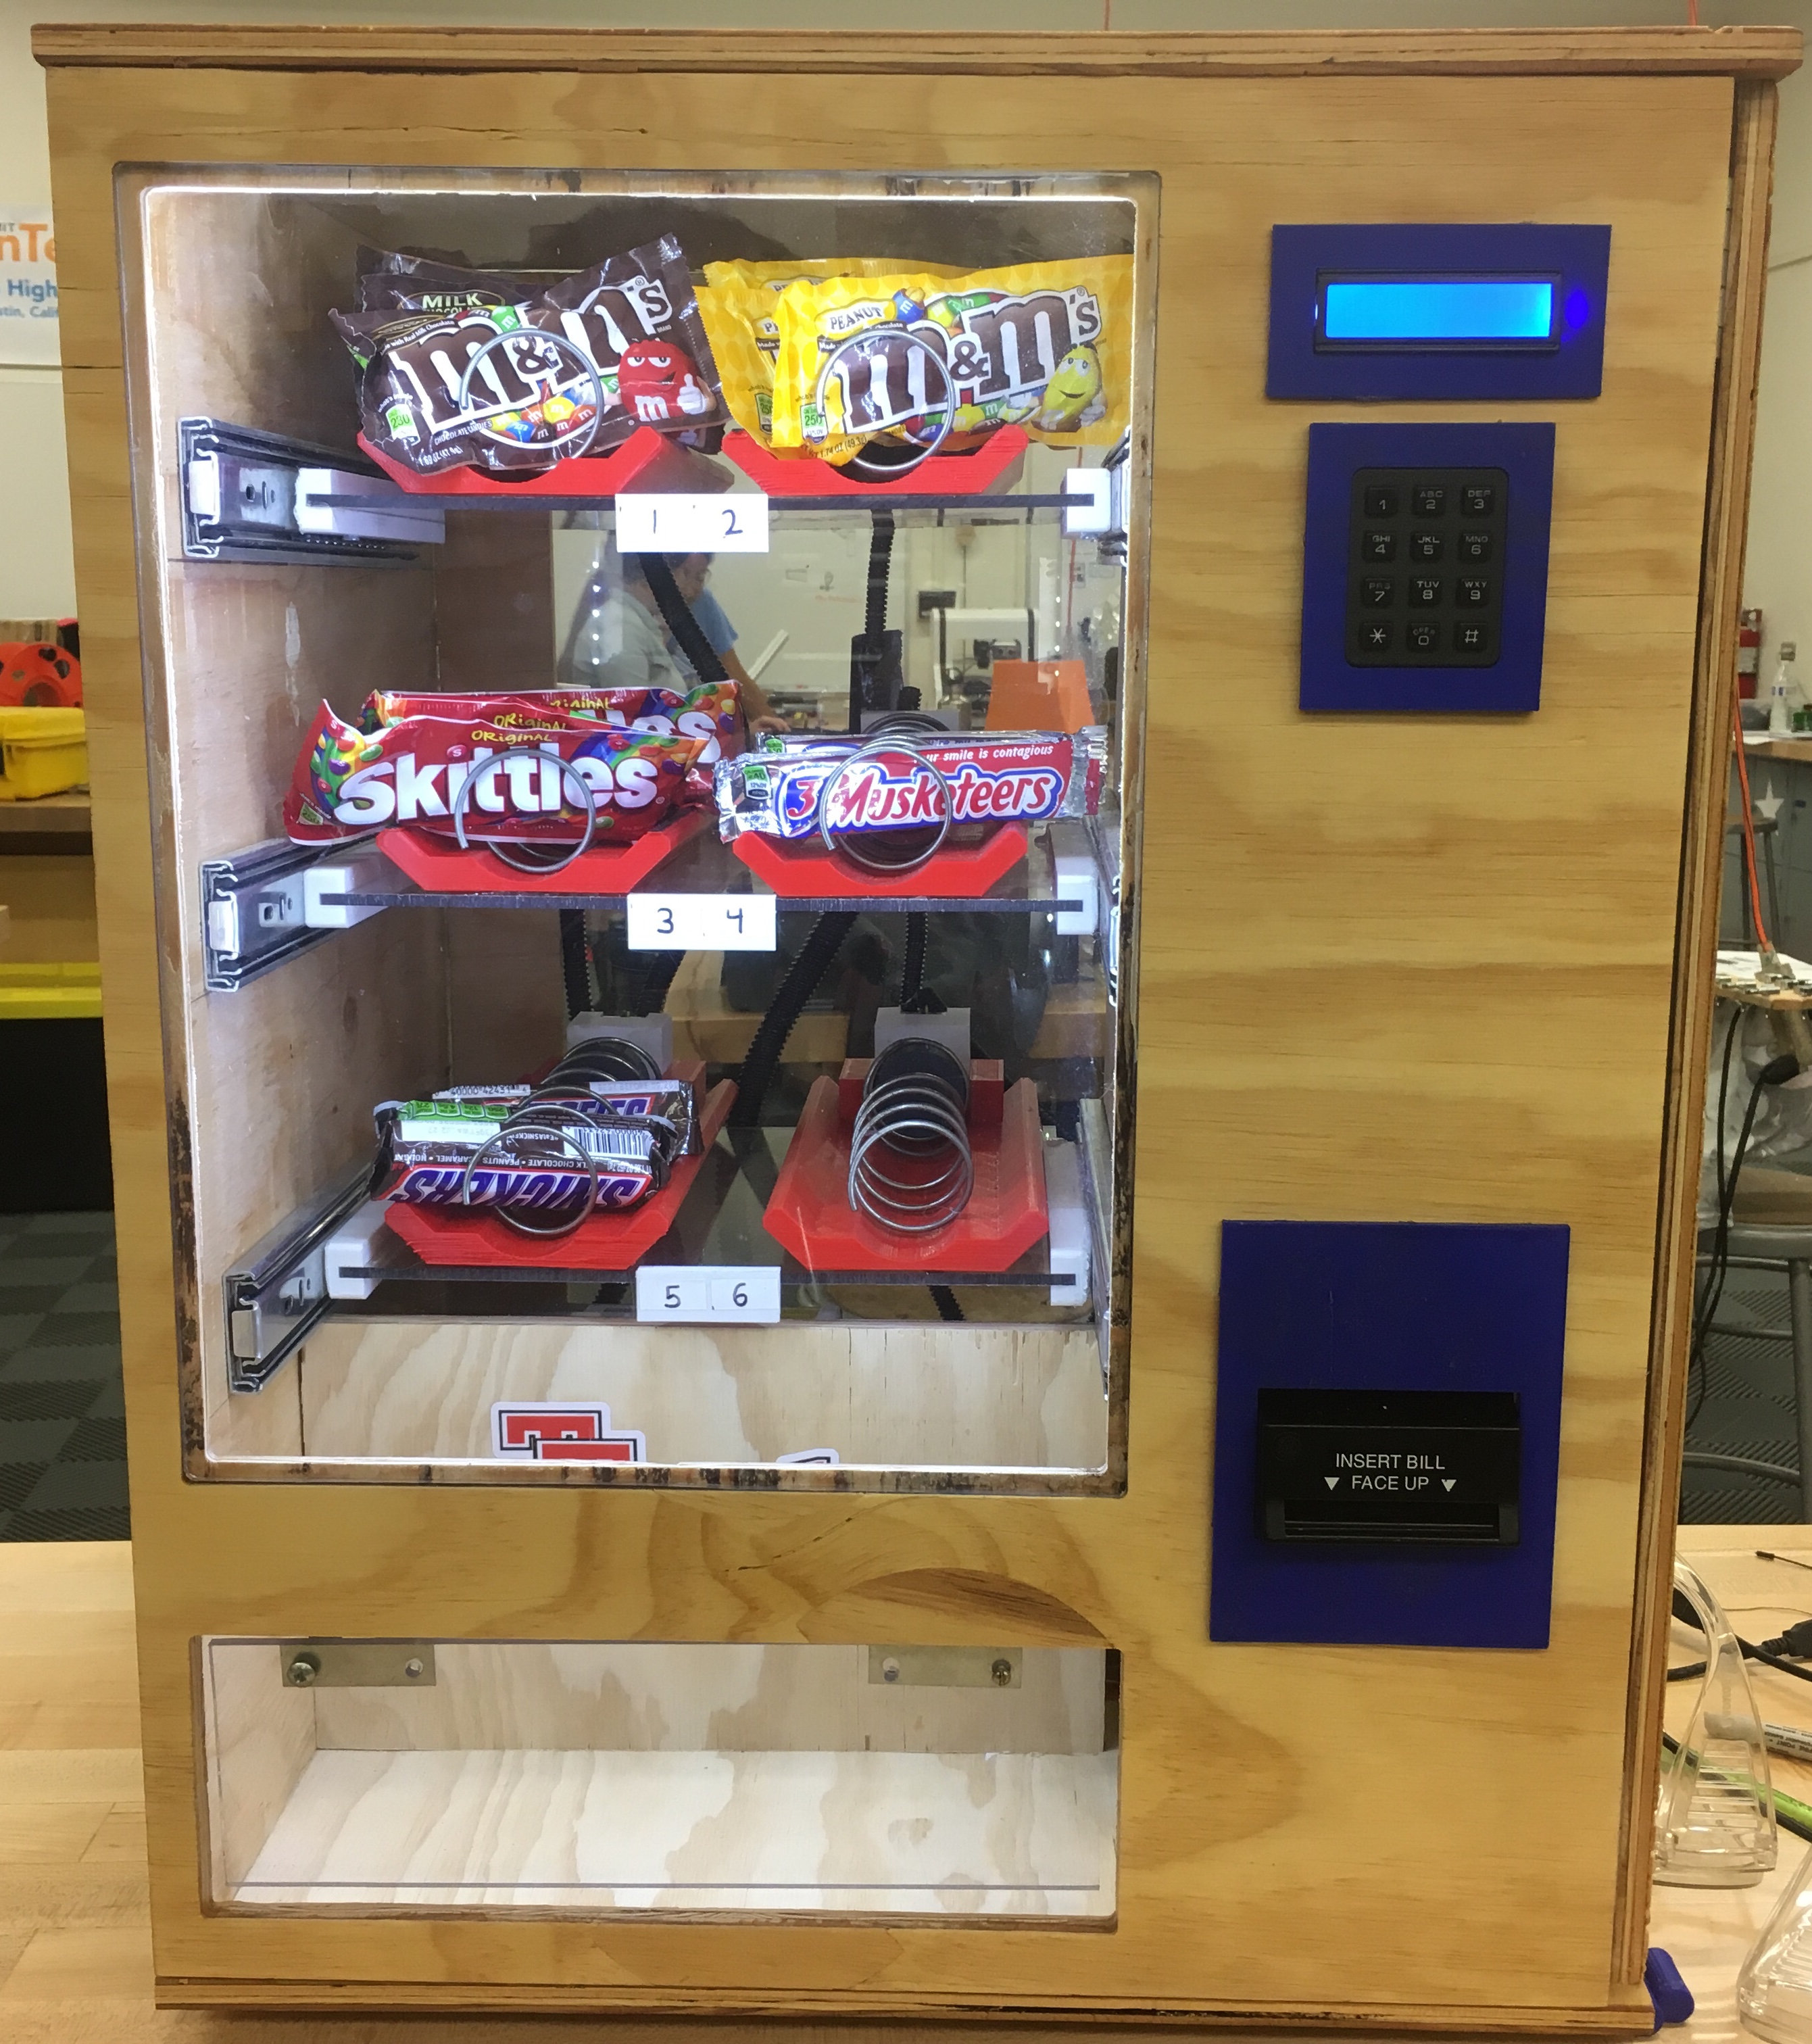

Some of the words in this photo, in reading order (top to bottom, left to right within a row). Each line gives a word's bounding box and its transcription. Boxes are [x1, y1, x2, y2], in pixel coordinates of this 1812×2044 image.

[7, 278, 57, 303] High
[422, 293, 483, 309] MILK
[829, 306, 883, 331] PEANUT
[635, 395, 671, 422] m
[1379, 499, 1386, 510] 1
[1425, 499, 1436, 510] 2
[1473, 498, 1485, 509] 3
[721, 508, 743, 535] 2
[1375, 543, 1386, 554] 4
[1423, 544, 1434, 555] 5
[1471, 544, 1482, 555] 6
[1417, 580, 1440, 589] TUV
[1465, 581, 1488, 589] WXY
[1375, 590, 1386, 602] 7
[1422, 589, 1434, 600] 8
[1470, 589, 1481, 600] 9
[942, 749, 974, 762] smile
[978, 748, 989, 760] is
[993, 744, 1054, 760] contagious
[785, 779, 818, 820] 3
[837, 764, 1051, 823] Musketeers
[656, 907, 675, 934] 3
[726, 906, 744, 934] 4
[482, 1157, 520, 1166] PEANUTS
[527, 1159, 574, 1168] CHOCOLATE
[664, 1284, 682, 1309] 5
[732, 1282, 748, 1307] 6
[1335, 1453, 1402, 1469] INSERT
[1406, 1455, 1446, 1470] BILL
[1351, 1475, 1399, 1491] FACE
[1404, 1476, 1430, 1491] UP
